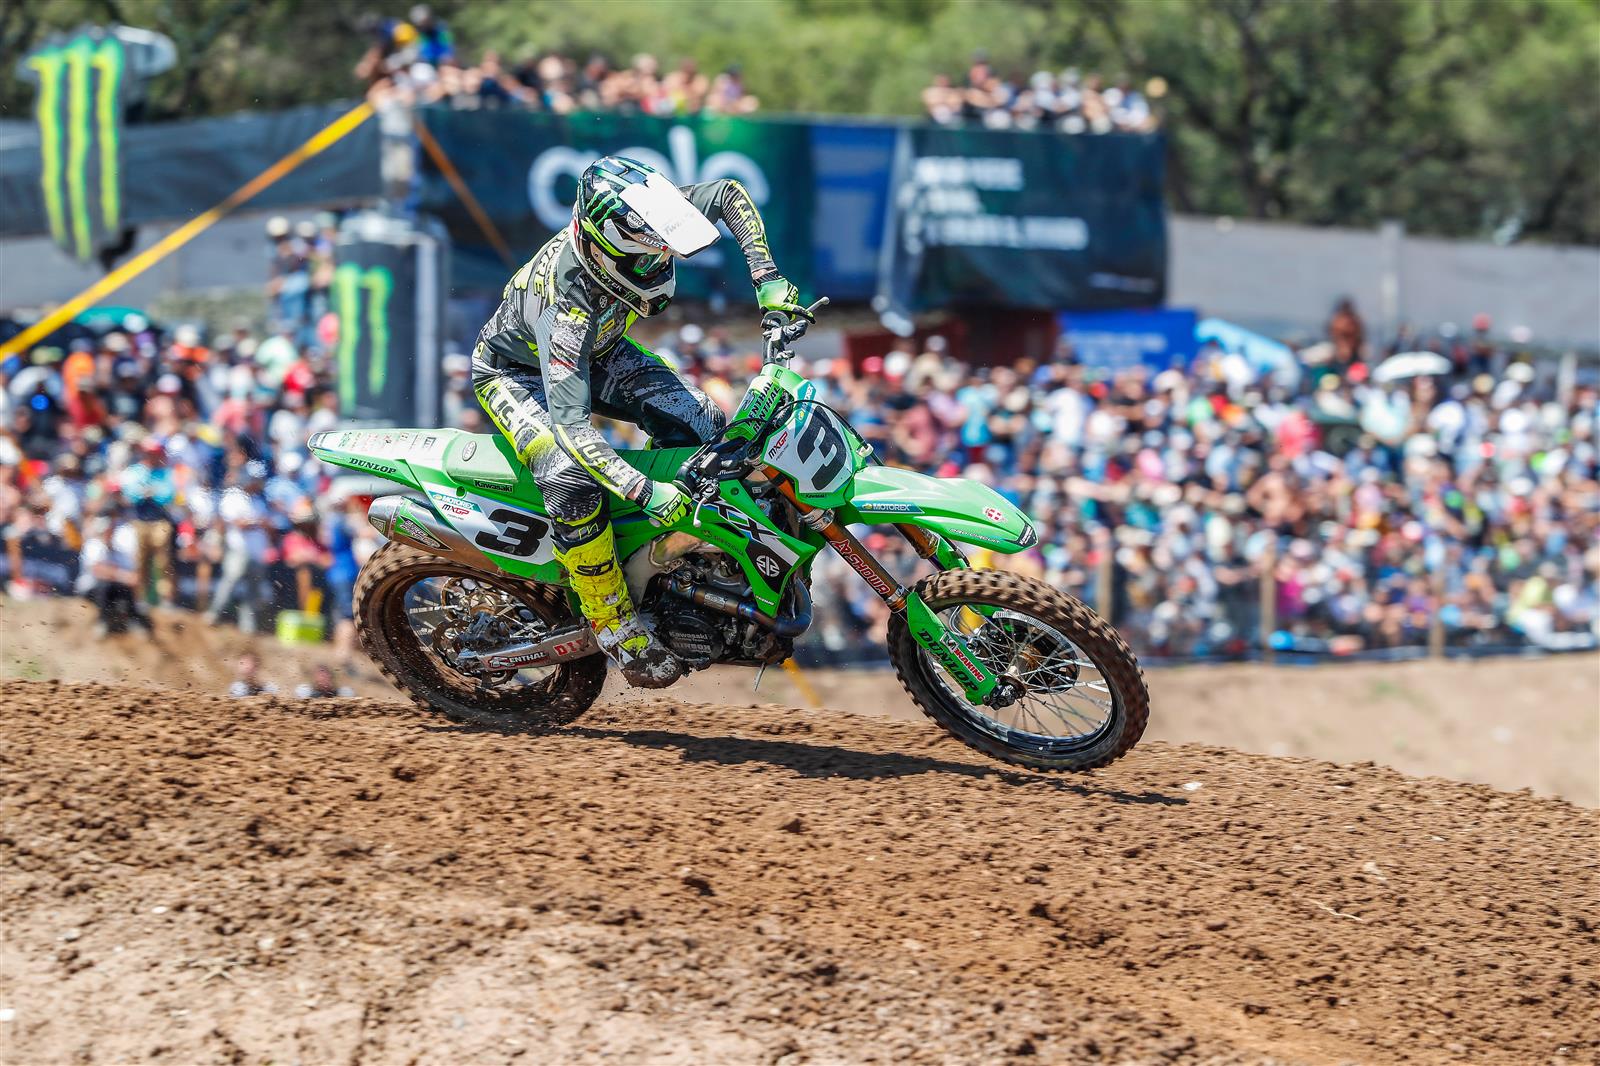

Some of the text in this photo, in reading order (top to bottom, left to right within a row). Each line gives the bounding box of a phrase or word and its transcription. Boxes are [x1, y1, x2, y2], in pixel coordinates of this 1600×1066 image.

[768, 431, 788, 460] MXGP
[797, 405, 847, 491] 3
[349, 458, 397, 474] DUNLOP
[474, 479, 513, 493] Kawasaki
[441, 503, 470, 515] MXGP
[872, 502, 911, 512] MOTOREX
[475, 508, 549, 557] 3
[916, 628, 979, 692] DUNLOP
[953, 648, 986, 682] BRAKING
